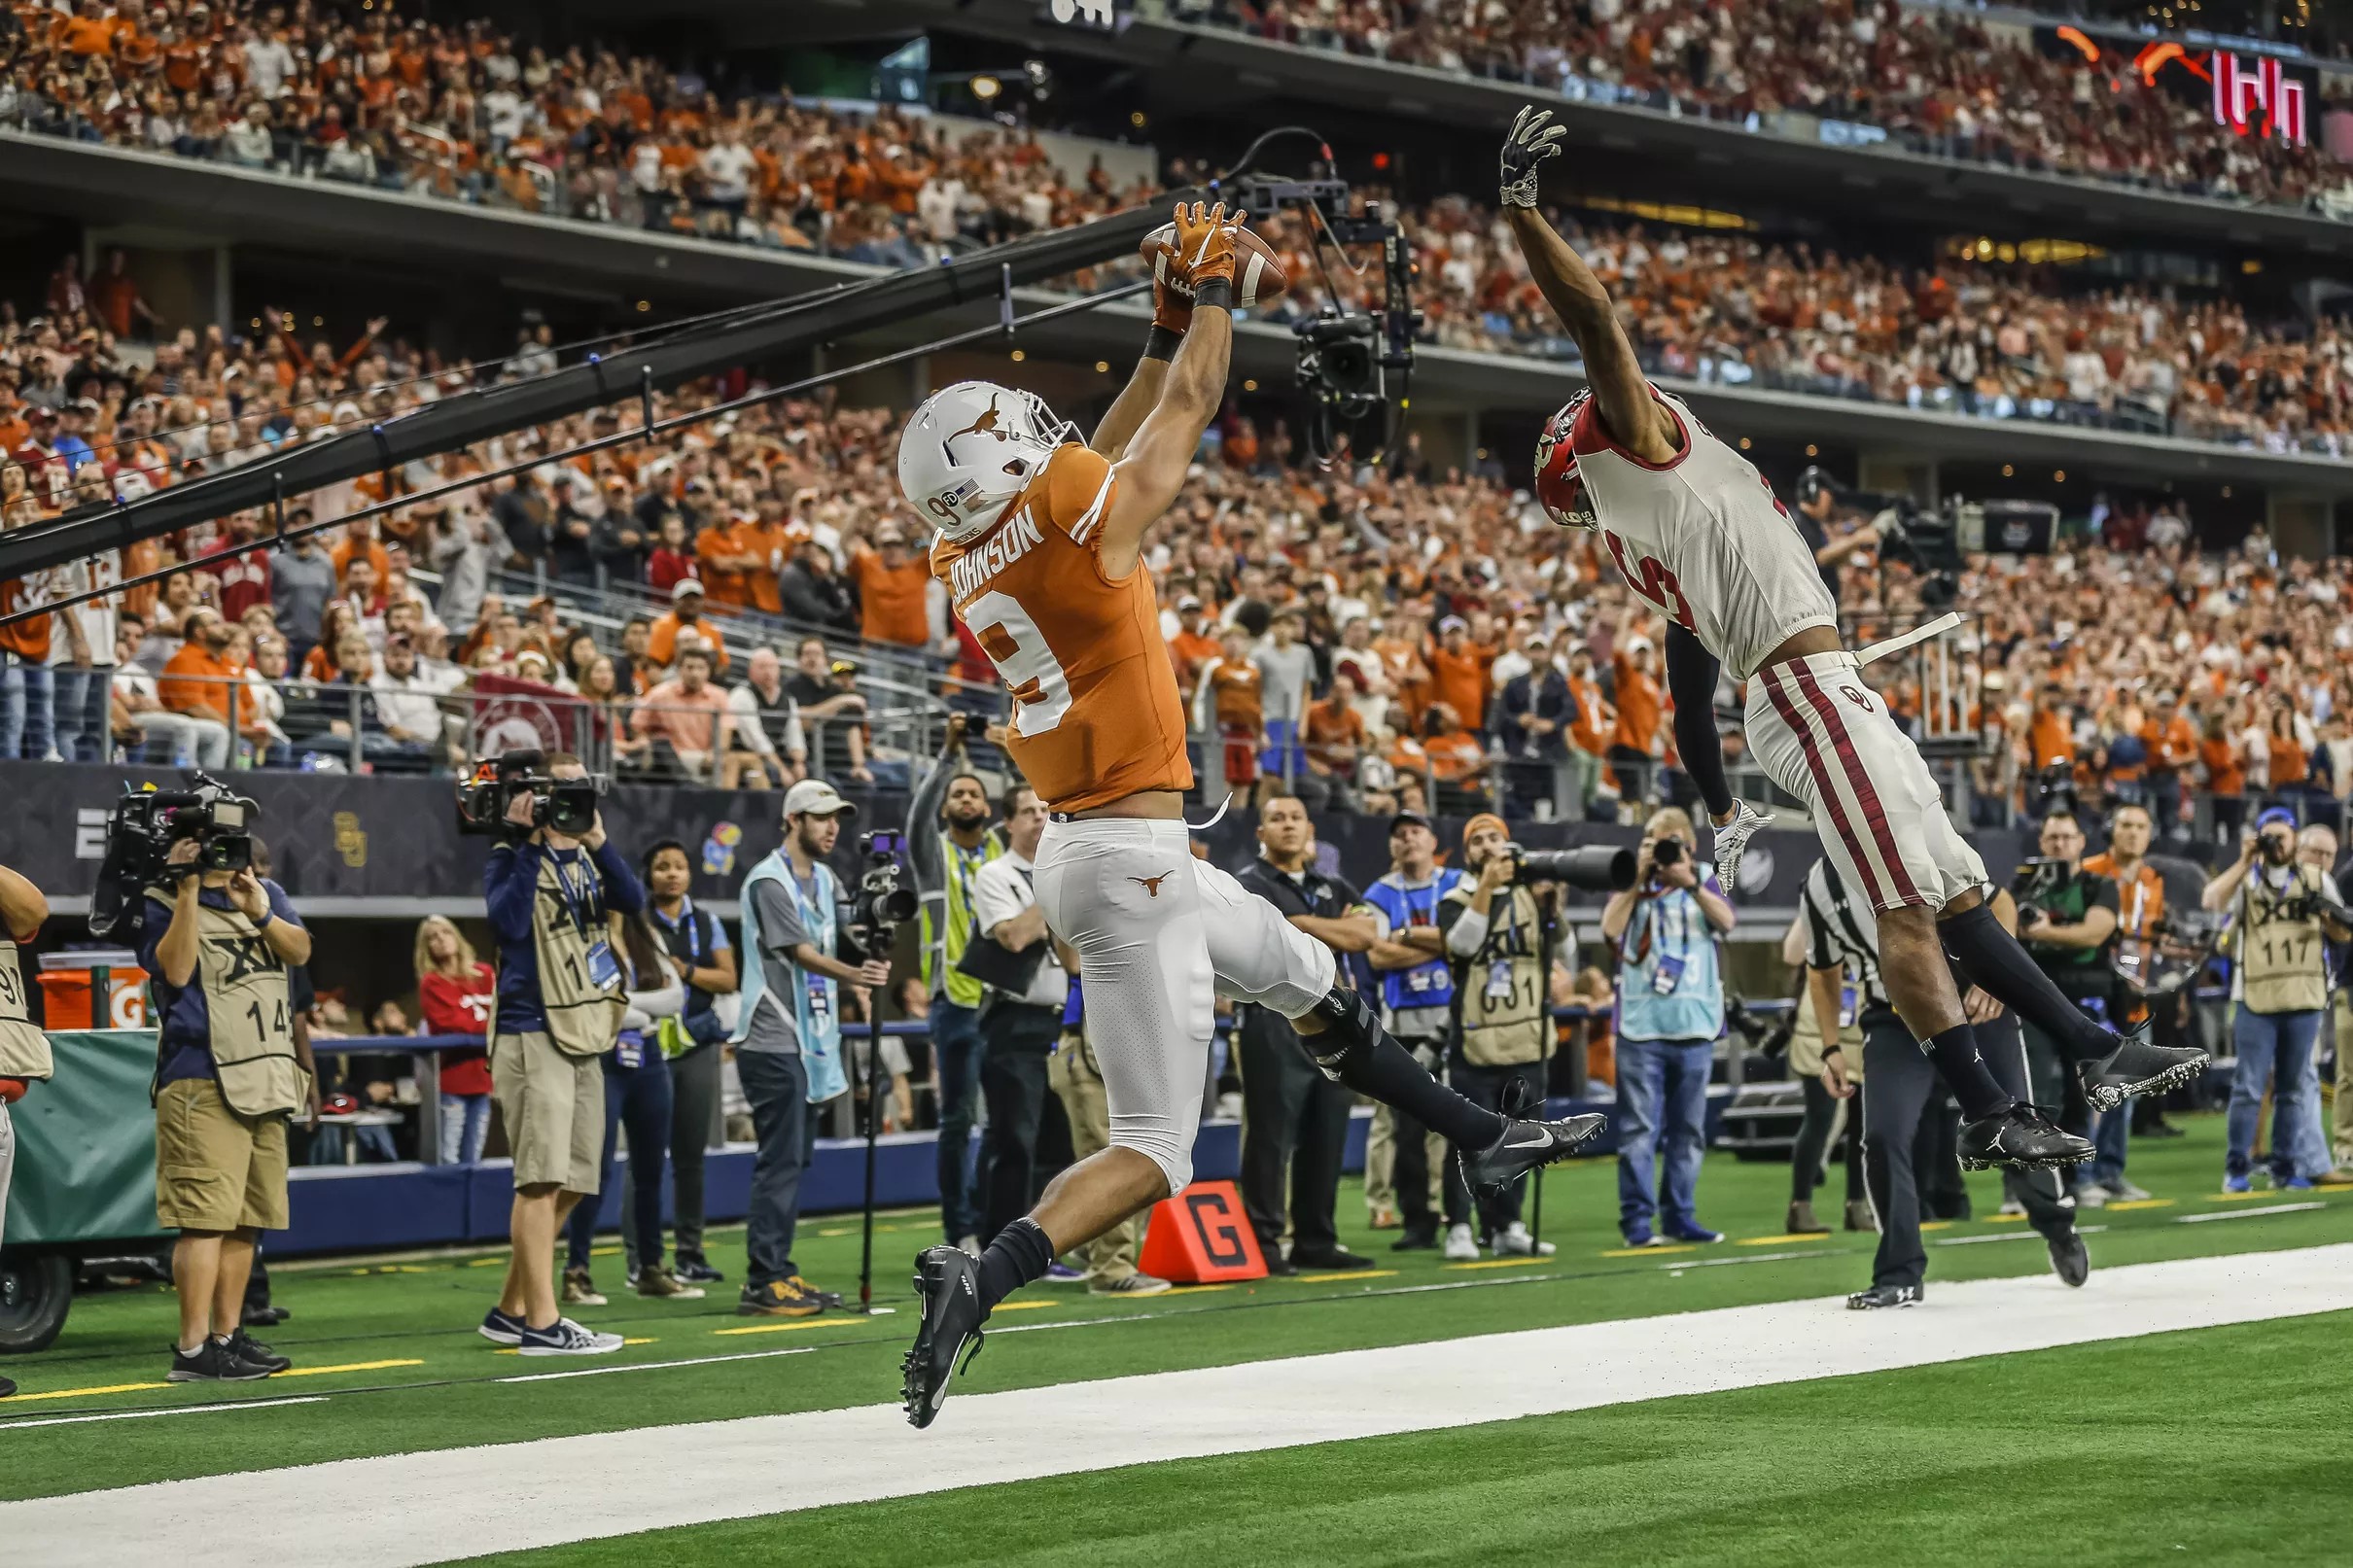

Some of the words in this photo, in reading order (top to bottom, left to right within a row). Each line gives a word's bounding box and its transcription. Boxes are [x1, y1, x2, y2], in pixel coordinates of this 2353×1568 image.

[927, 497, 962, 527] 9
[950, 504, 1045, 605] JOHNSON
[965, 589, 1073, 738] 9
[1839, 684, 1875, 714] OU
[2262, 935, 2316, 966] 117
[111, 985, 144, 1028] G
[246, 998, 295, 1043] 14
[1185, 1193, 1248, 1268] G
